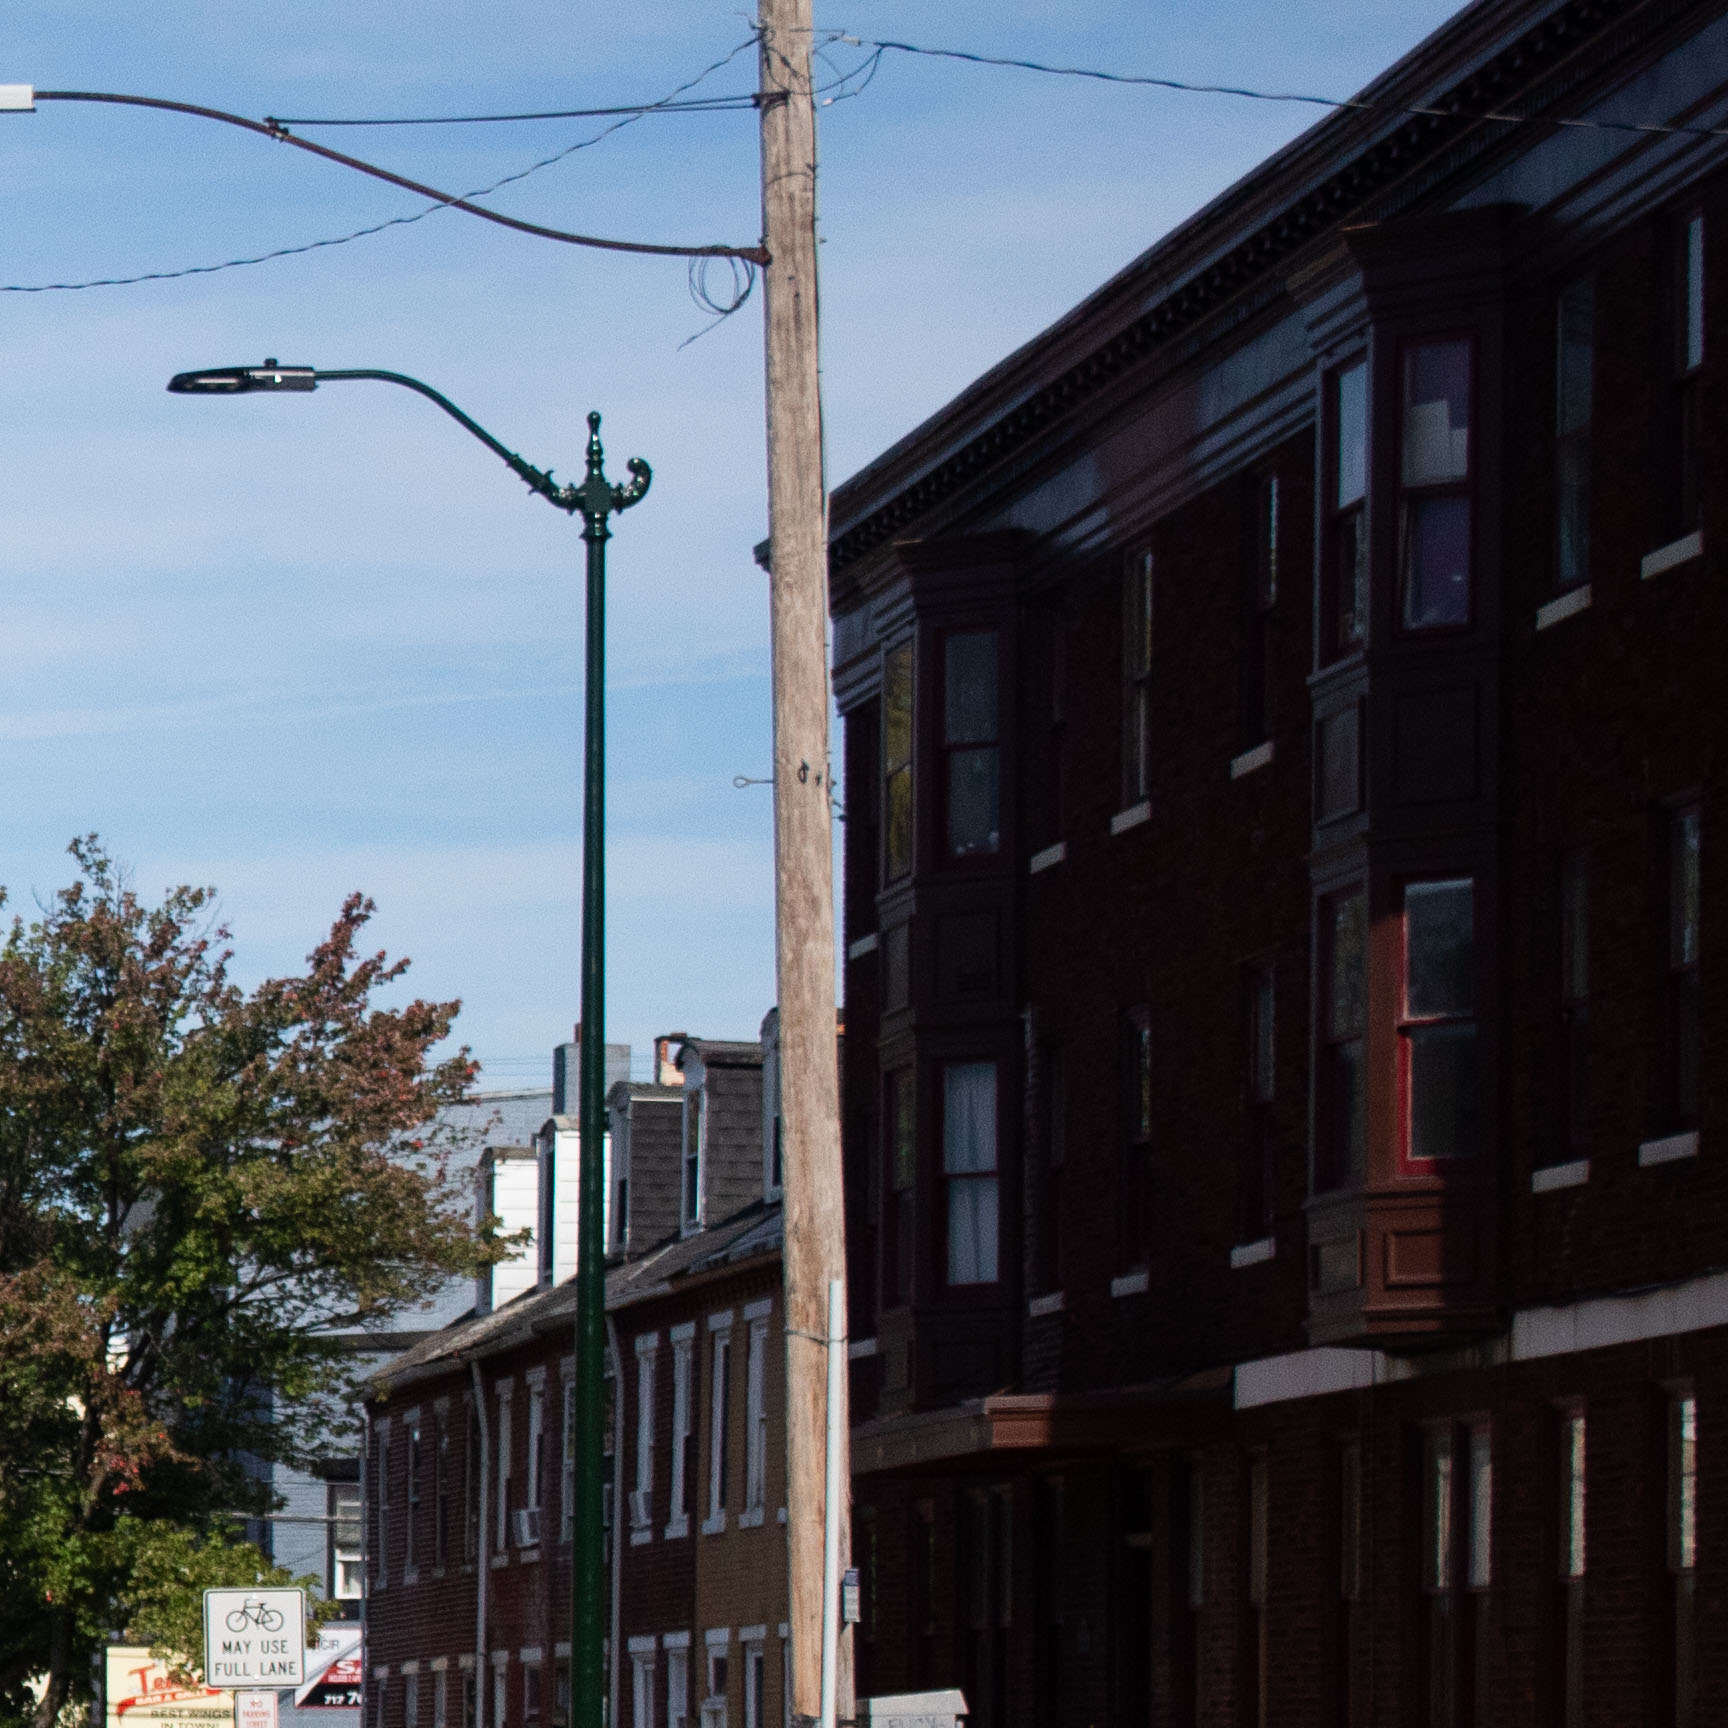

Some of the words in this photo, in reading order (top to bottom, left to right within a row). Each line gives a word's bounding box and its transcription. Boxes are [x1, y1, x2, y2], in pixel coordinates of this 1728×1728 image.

[222, 1640, 251, 1654] MAY
[260, 1640, 288, 1654] USE
[214, 1662, 251, 1676] FULL
[260, 1661, 297, 1676] LANE
[150, 1710, 184, 1719] BEST
